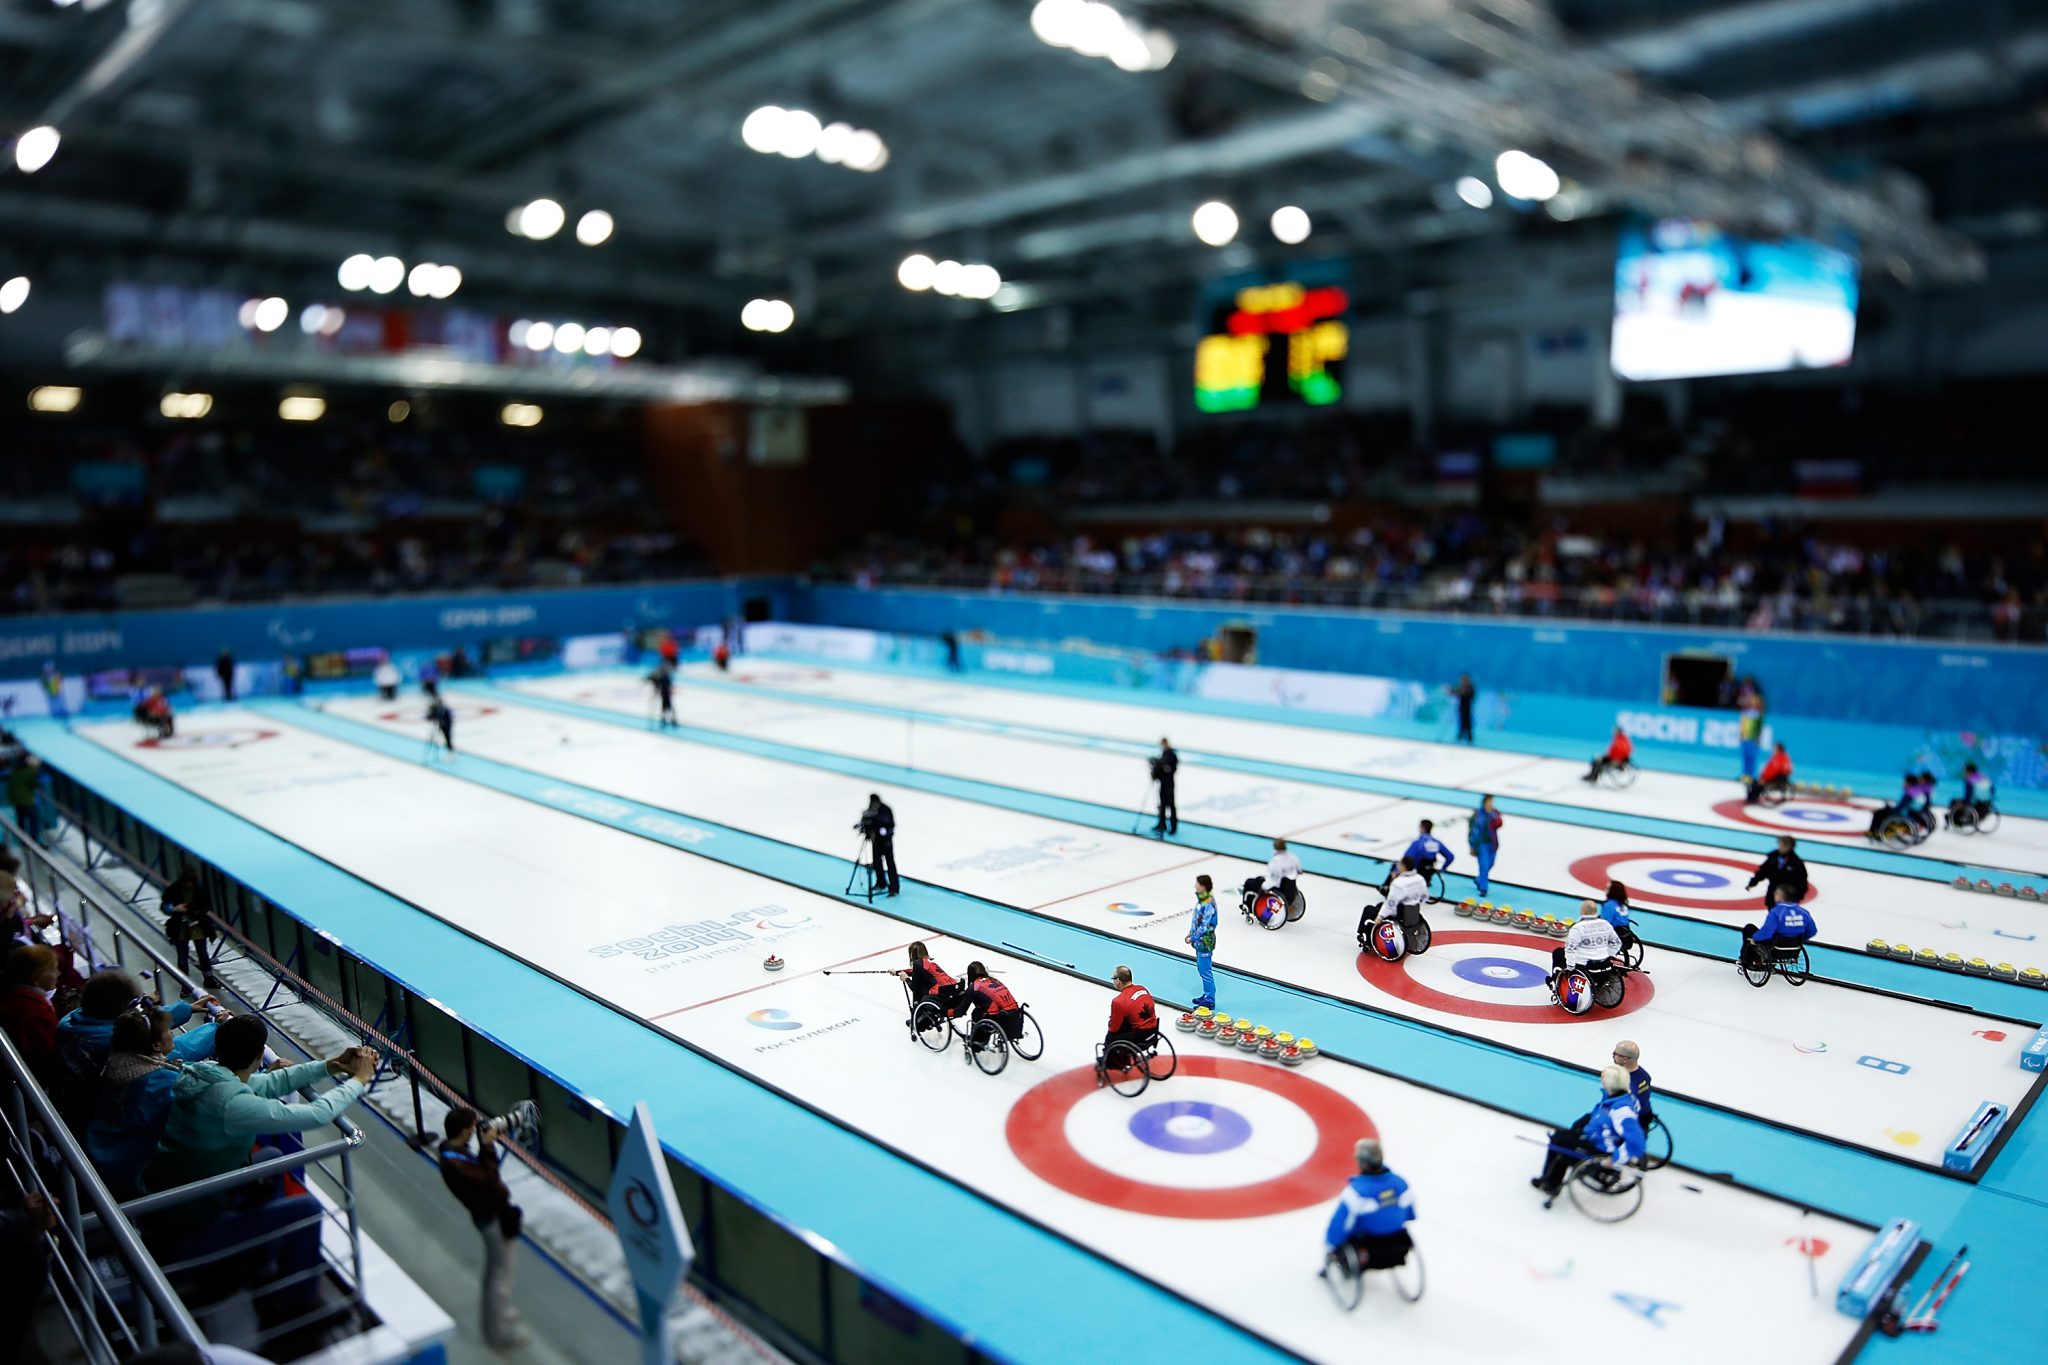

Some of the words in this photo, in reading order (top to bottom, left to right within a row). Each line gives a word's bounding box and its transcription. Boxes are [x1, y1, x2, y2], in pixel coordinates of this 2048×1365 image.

[1703, 718, 1773, 750] 204
[588, 903, 788, 958] sochi.ru
[633, 927, 754, 961] 2014
[645, 939, 758, 975] paralympic
[762, 923, 824, 944] games
[754, 1016, 861, 1054] Ростелеком
[1856, 1055, 1911, 1075] B
[1611, 1289, 1684, 1330] A
